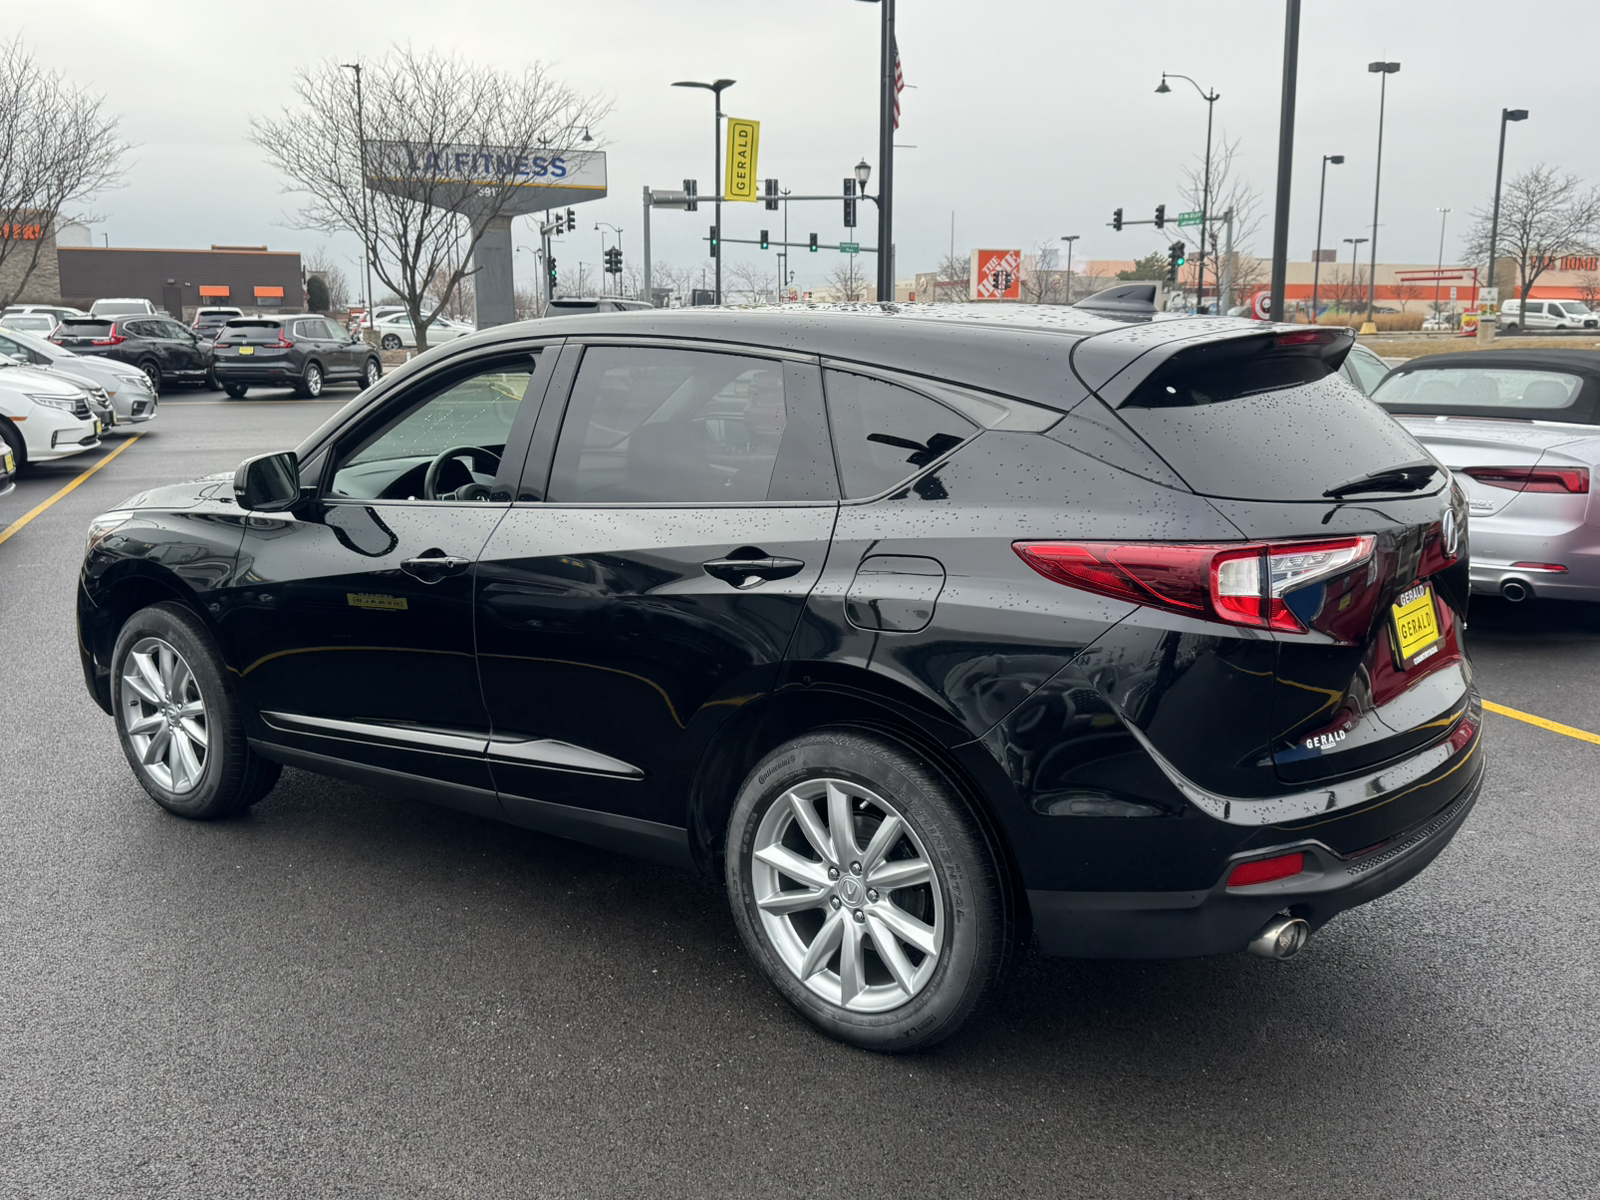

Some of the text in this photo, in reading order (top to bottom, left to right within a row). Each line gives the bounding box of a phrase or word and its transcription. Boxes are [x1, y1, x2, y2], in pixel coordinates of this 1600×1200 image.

[455, 152, 567, 178] FITNESS
[736, 130, 749, 190] GERALD
[982, 255, 1000, 274] THE
[1561, 255, 1597, 272] HOME
[1400, 585, 1425, 606] GERALD
[1401, 612, 1433, 639] GERALD
[1306, 730, 1346, 749] GERALD
[886, 779, 965, 924] CONTINENTAL
[903, 1026, 919, 1038] LX
